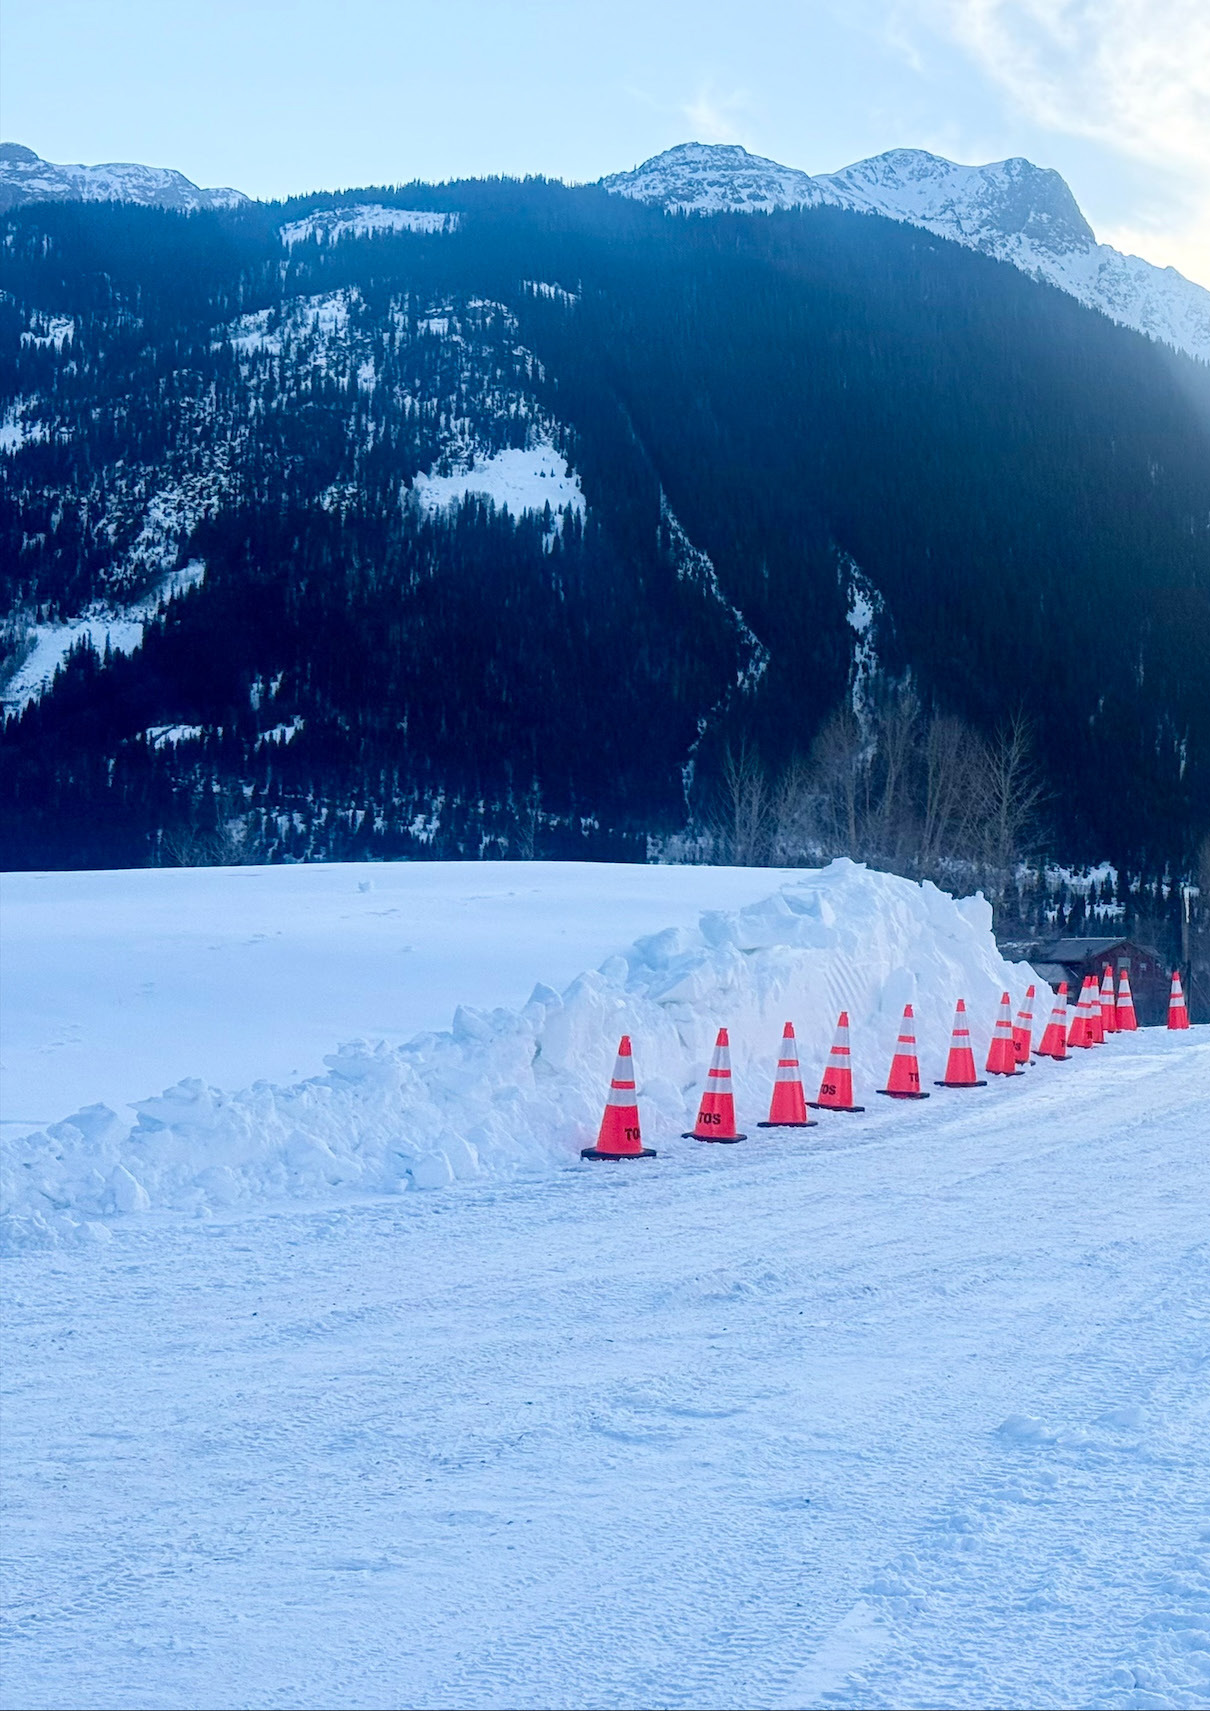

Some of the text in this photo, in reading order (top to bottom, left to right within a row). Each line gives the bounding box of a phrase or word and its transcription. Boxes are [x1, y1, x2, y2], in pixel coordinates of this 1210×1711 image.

[909, 1072, 920, 1083] TO
[698, 1111, 721, 1125] TOS
[624, 1127, 641, 1142] TO
